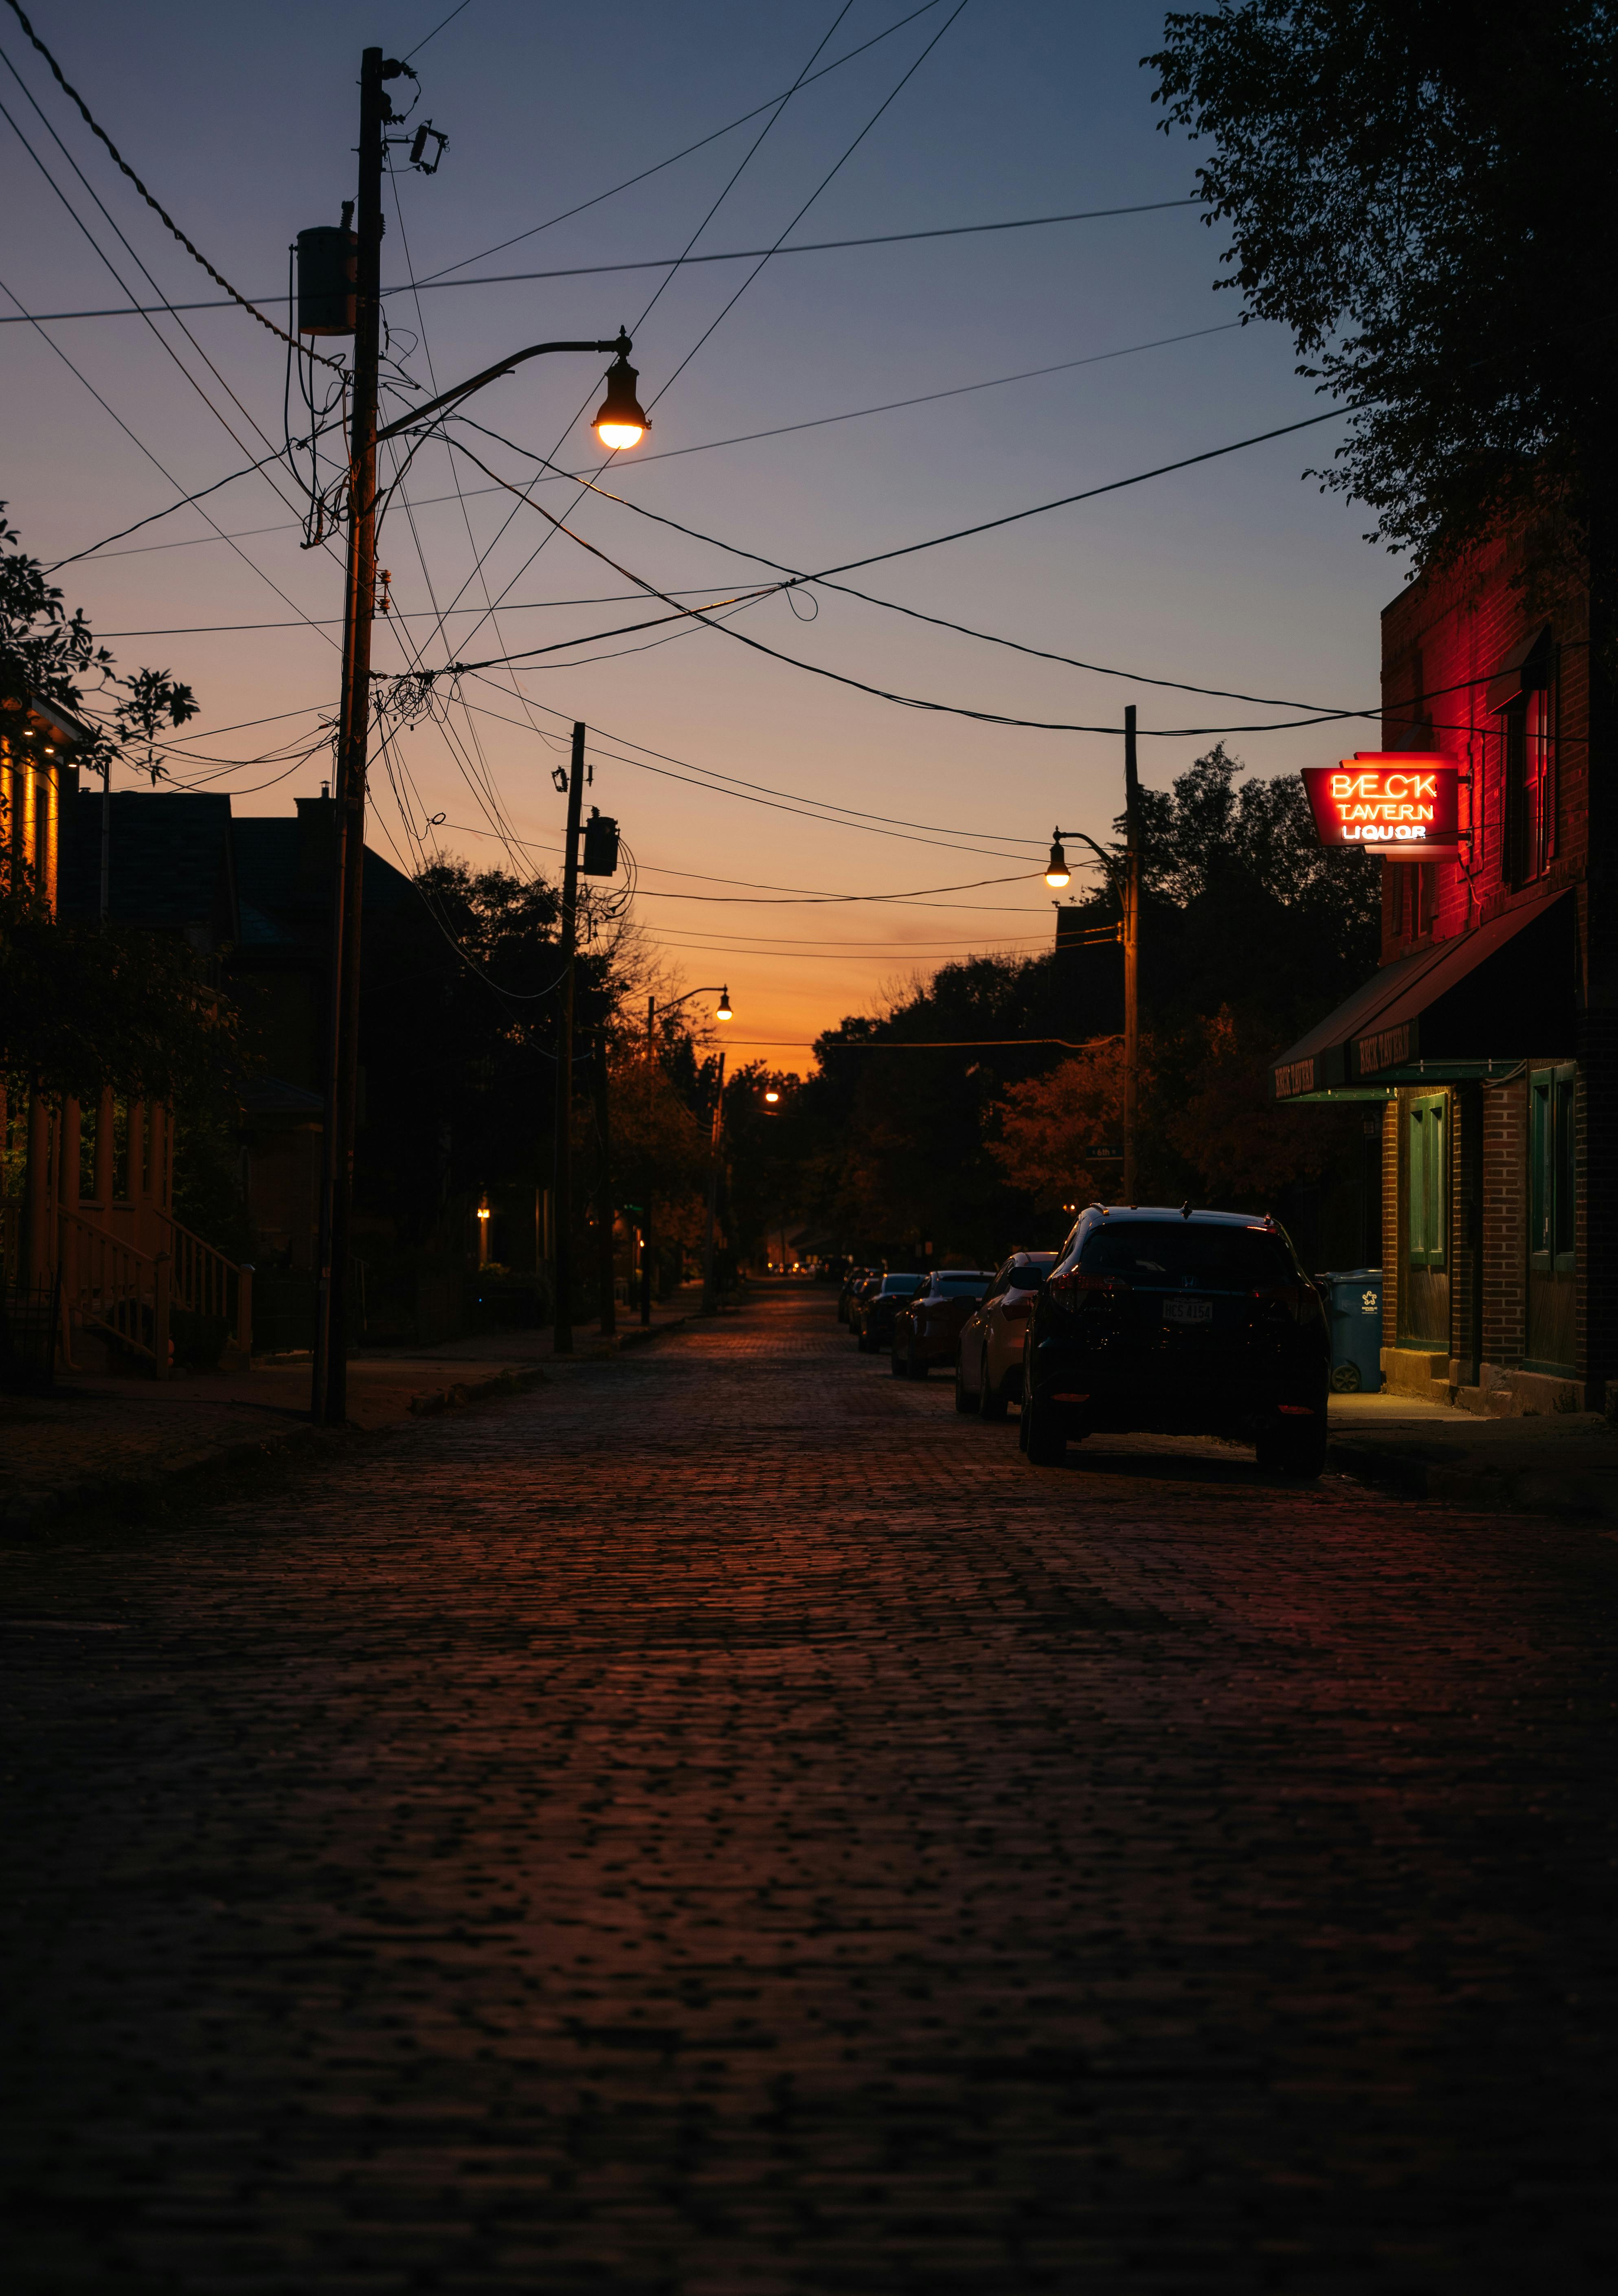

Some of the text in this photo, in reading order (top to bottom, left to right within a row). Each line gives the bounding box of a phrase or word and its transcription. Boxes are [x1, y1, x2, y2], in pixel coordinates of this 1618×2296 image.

[1331, 775, 1437, 798] BECK
[1337, 804, 1433, 820] TAVERN
[1342, 825, 1426, 840] LIQUOR
[1359, 1023, 1409, 1075] BECK TAVERN
[1187, 1305, 1210, 1319] 4154
